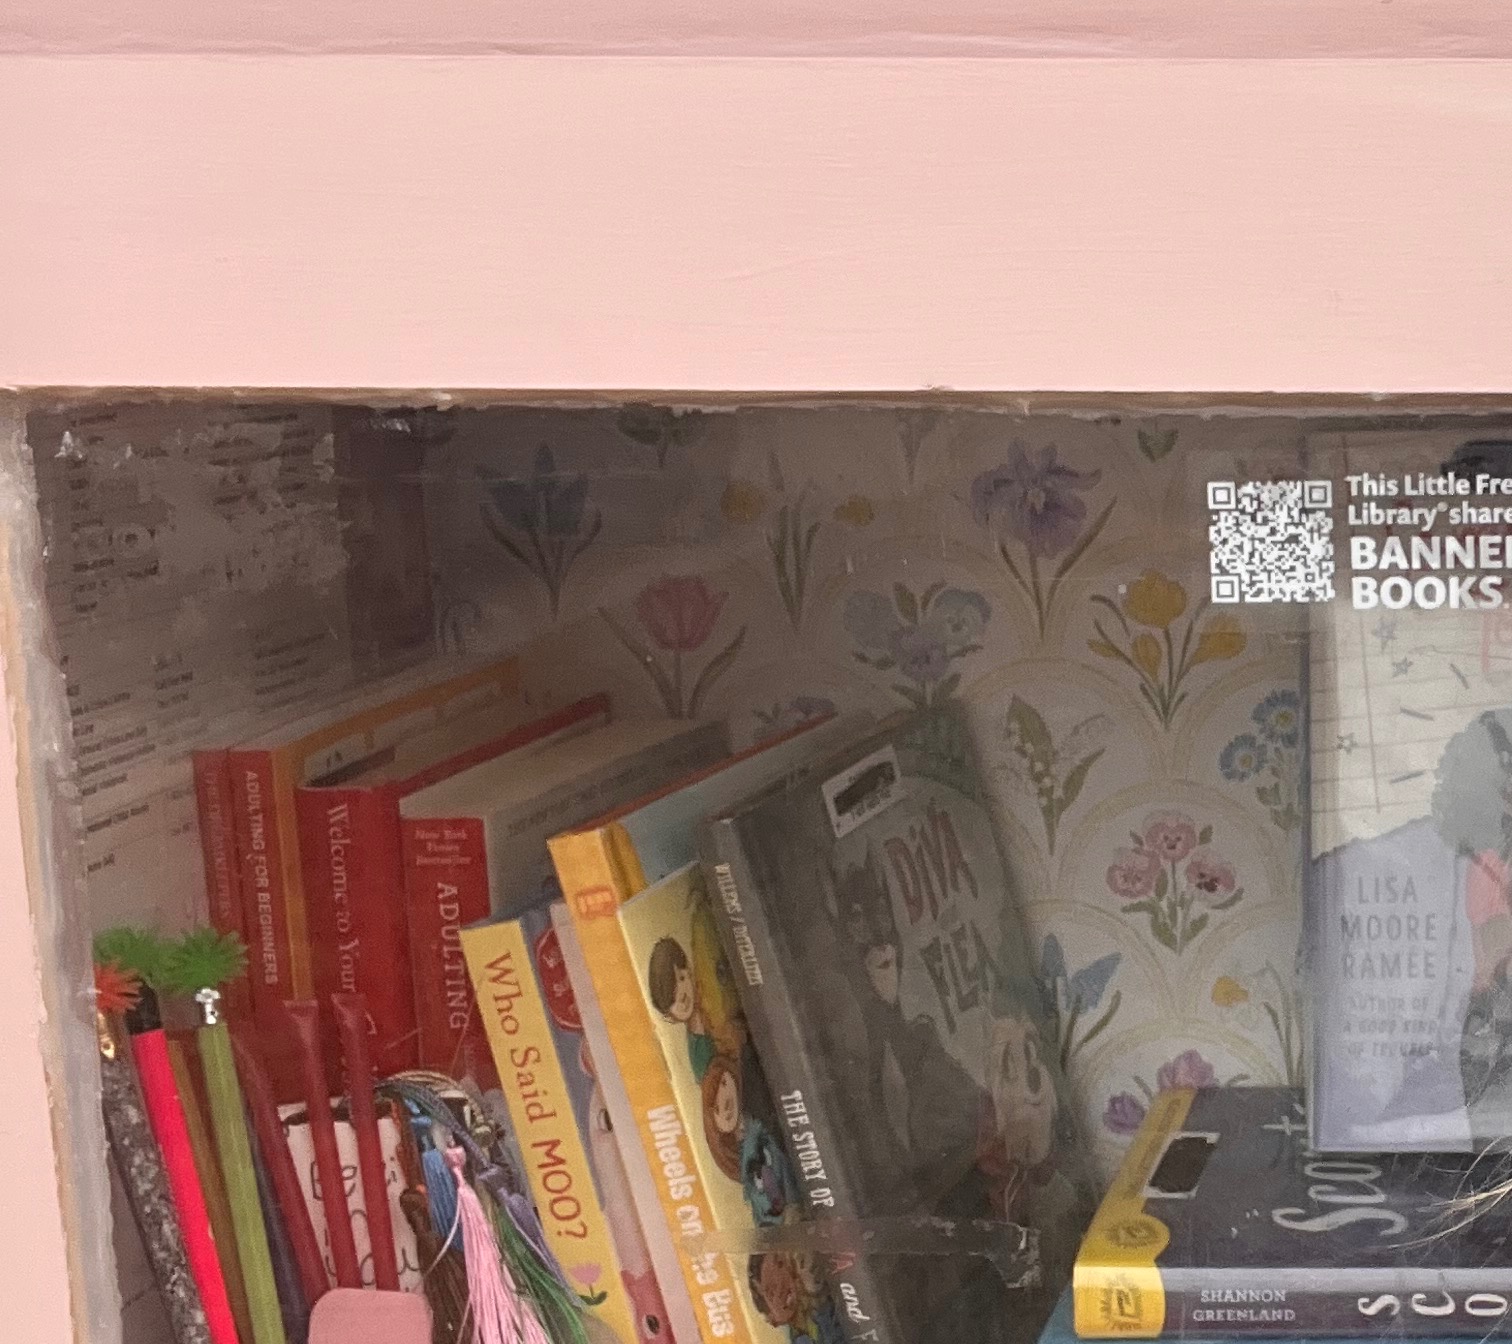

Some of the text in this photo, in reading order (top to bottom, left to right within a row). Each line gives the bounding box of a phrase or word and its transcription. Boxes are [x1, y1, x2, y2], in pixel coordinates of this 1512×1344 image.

[1347, 473, 1399, 497] This
[1404, 471, 1470, 497] Little
[1349, 502, 1439, 532] Library
[246, 770, 278, 986] ADULTING FOR BEGINNERS
[326, 803, 360, 992] Welcome to Your
[1358, 875, 1419, 905] LISA
[1340, 913, 1438, 942] MOORE
[437, 881, 470, 1030] ADULTING
[921, 919, 998, 1036] FLEA
[484, 951, 524, 1036] Who
[510, 1045, 558, 1125] Said
[780, 1089, 810, 1128] THE
[792, 1130, 827, 1182] STORY
[531, 1138, 588, 1241] MOO?
[810, 1187, 835, 1208] OF
[647, 1104, 697, 1202] Wheels
[702, 1288, 735, 1339] Bus
[840, 1282, 870, 1324] and
[1192, 1309, 1296, 1323] GREENLAND
[1200, 1288, 1287, 1304] SHANNON
